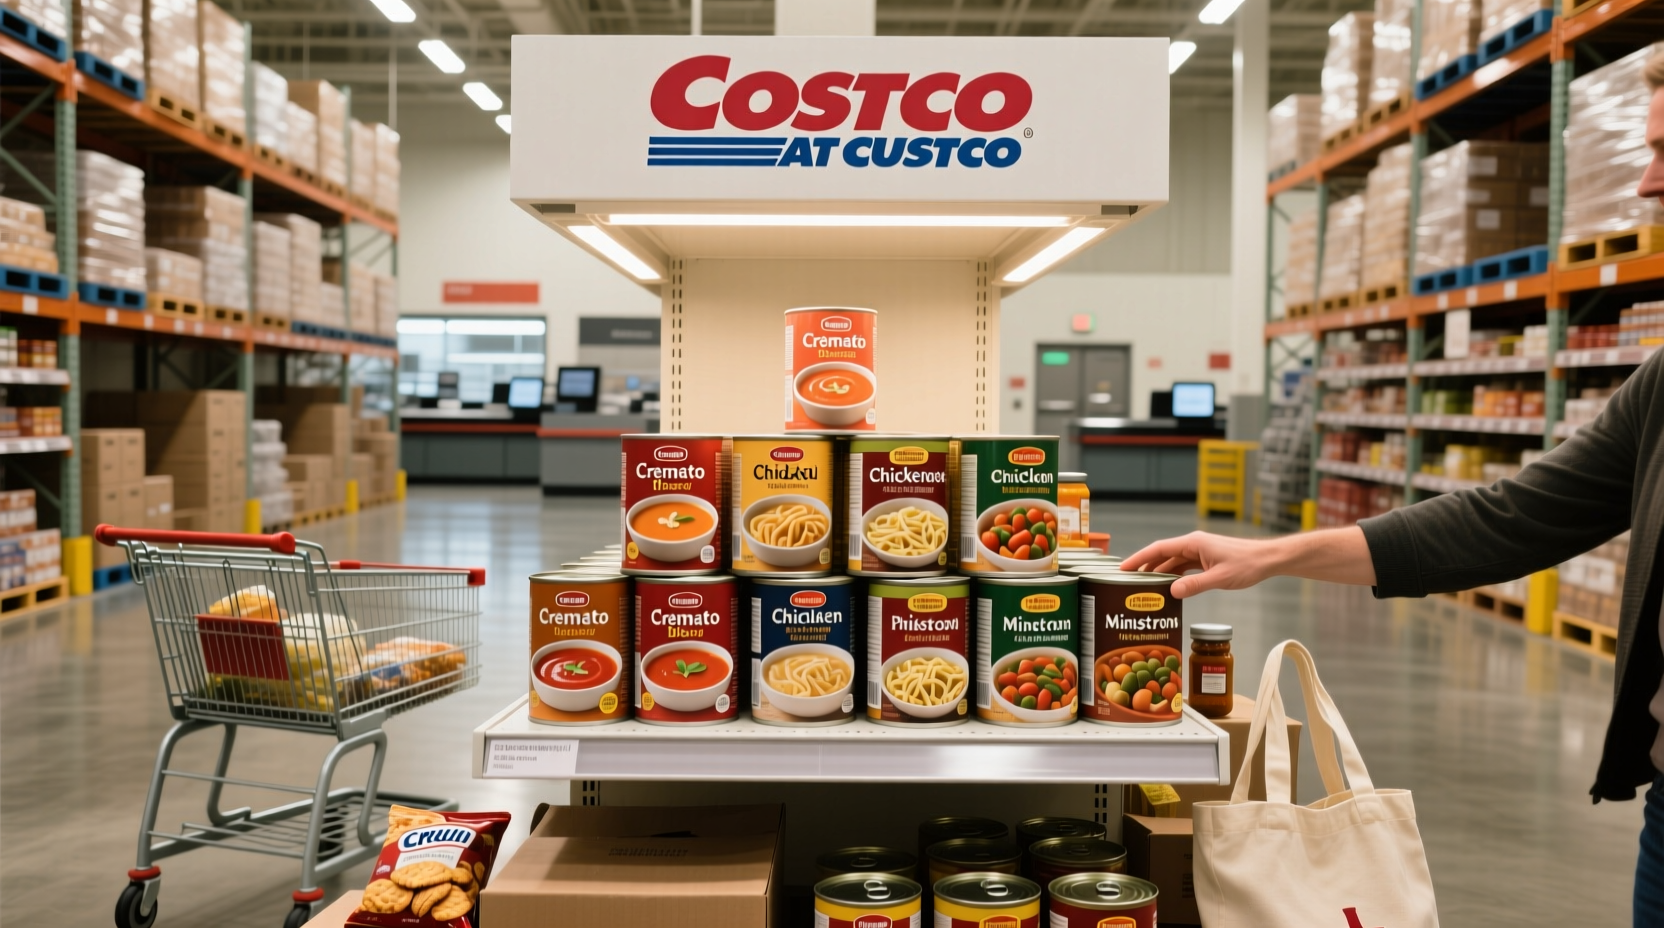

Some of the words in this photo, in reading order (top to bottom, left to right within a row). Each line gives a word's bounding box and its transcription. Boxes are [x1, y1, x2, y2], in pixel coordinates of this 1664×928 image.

[650, 55, 1033, 132] COSTCO
[777, 137, 841, 167] AT
[842, 137, 1022, 168] CUSTCO
[636, 462, 706, 480] Cremato
[539, 607, 609, 625] Cremato
[651, 608, 720, 626] Cremato
